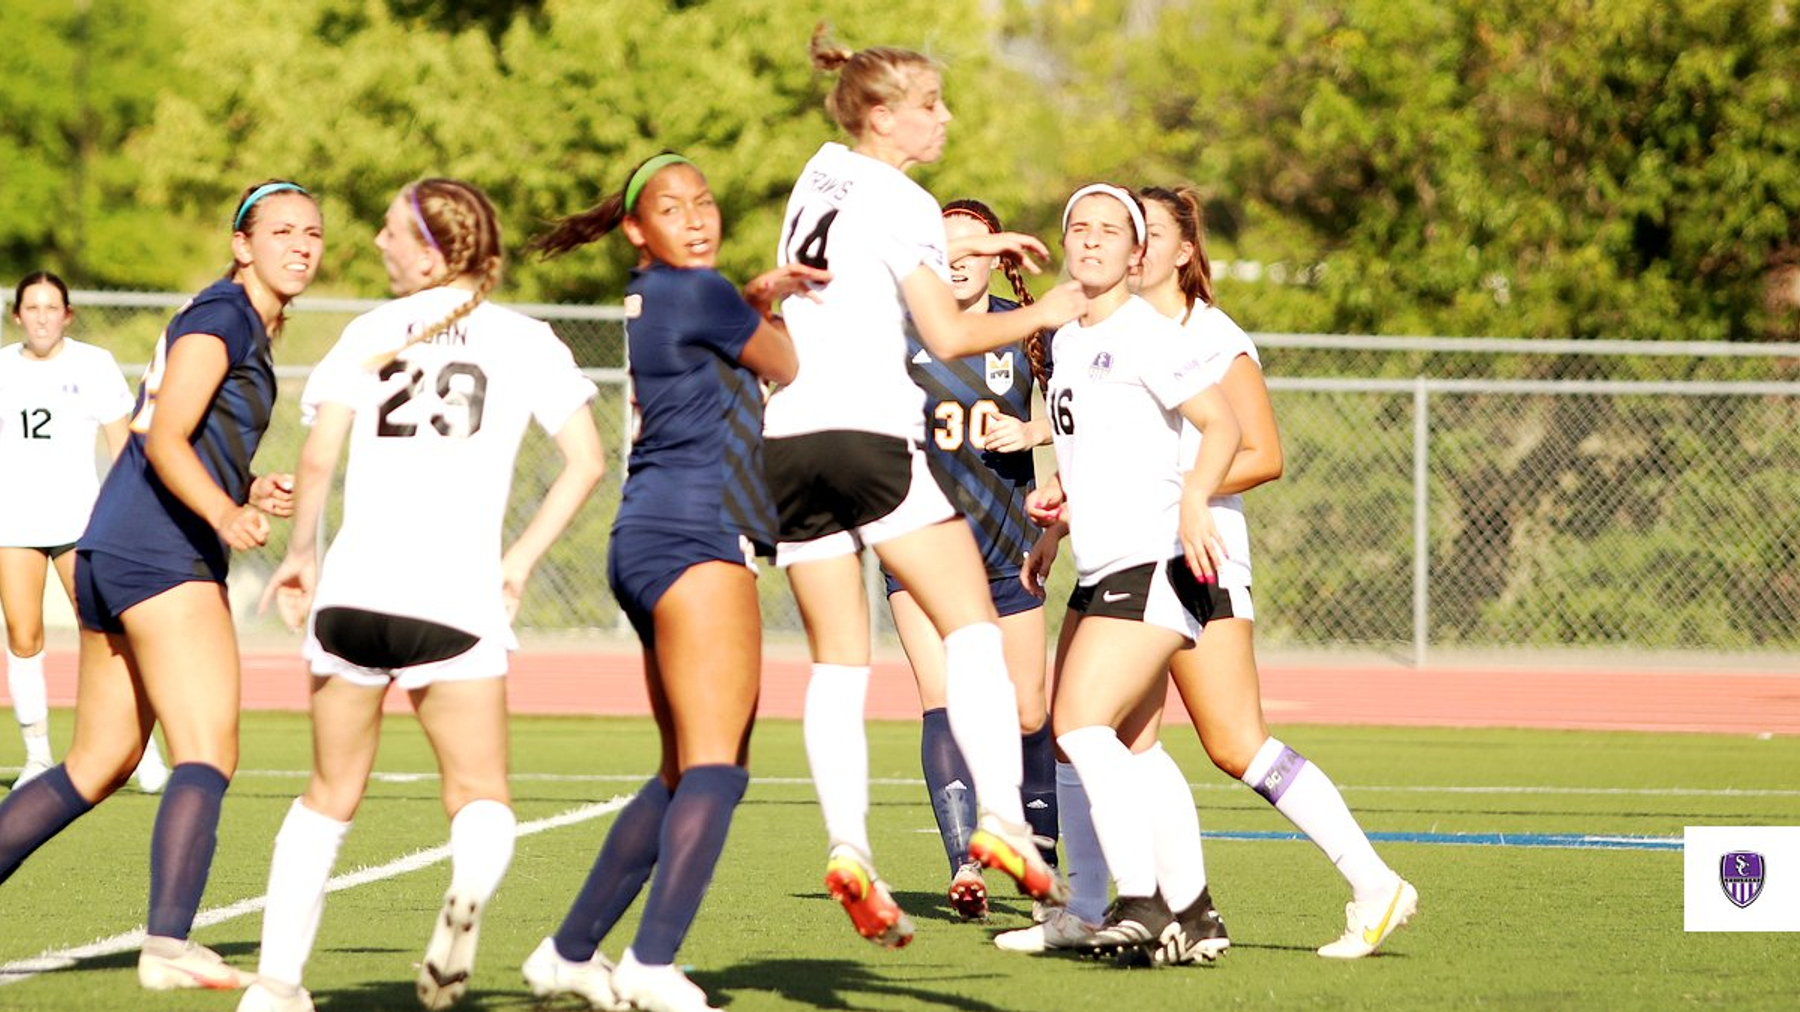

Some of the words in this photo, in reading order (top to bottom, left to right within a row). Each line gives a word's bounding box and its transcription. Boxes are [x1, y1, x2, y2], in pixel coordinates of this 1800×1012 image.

[785, 206, 839, 280] 14
[20, 408, 52, 439] 12
[377, 358, 488, 437] 29
[1051, 388, 1075, 435] 16
[934, 399, 1001, 451] 30
